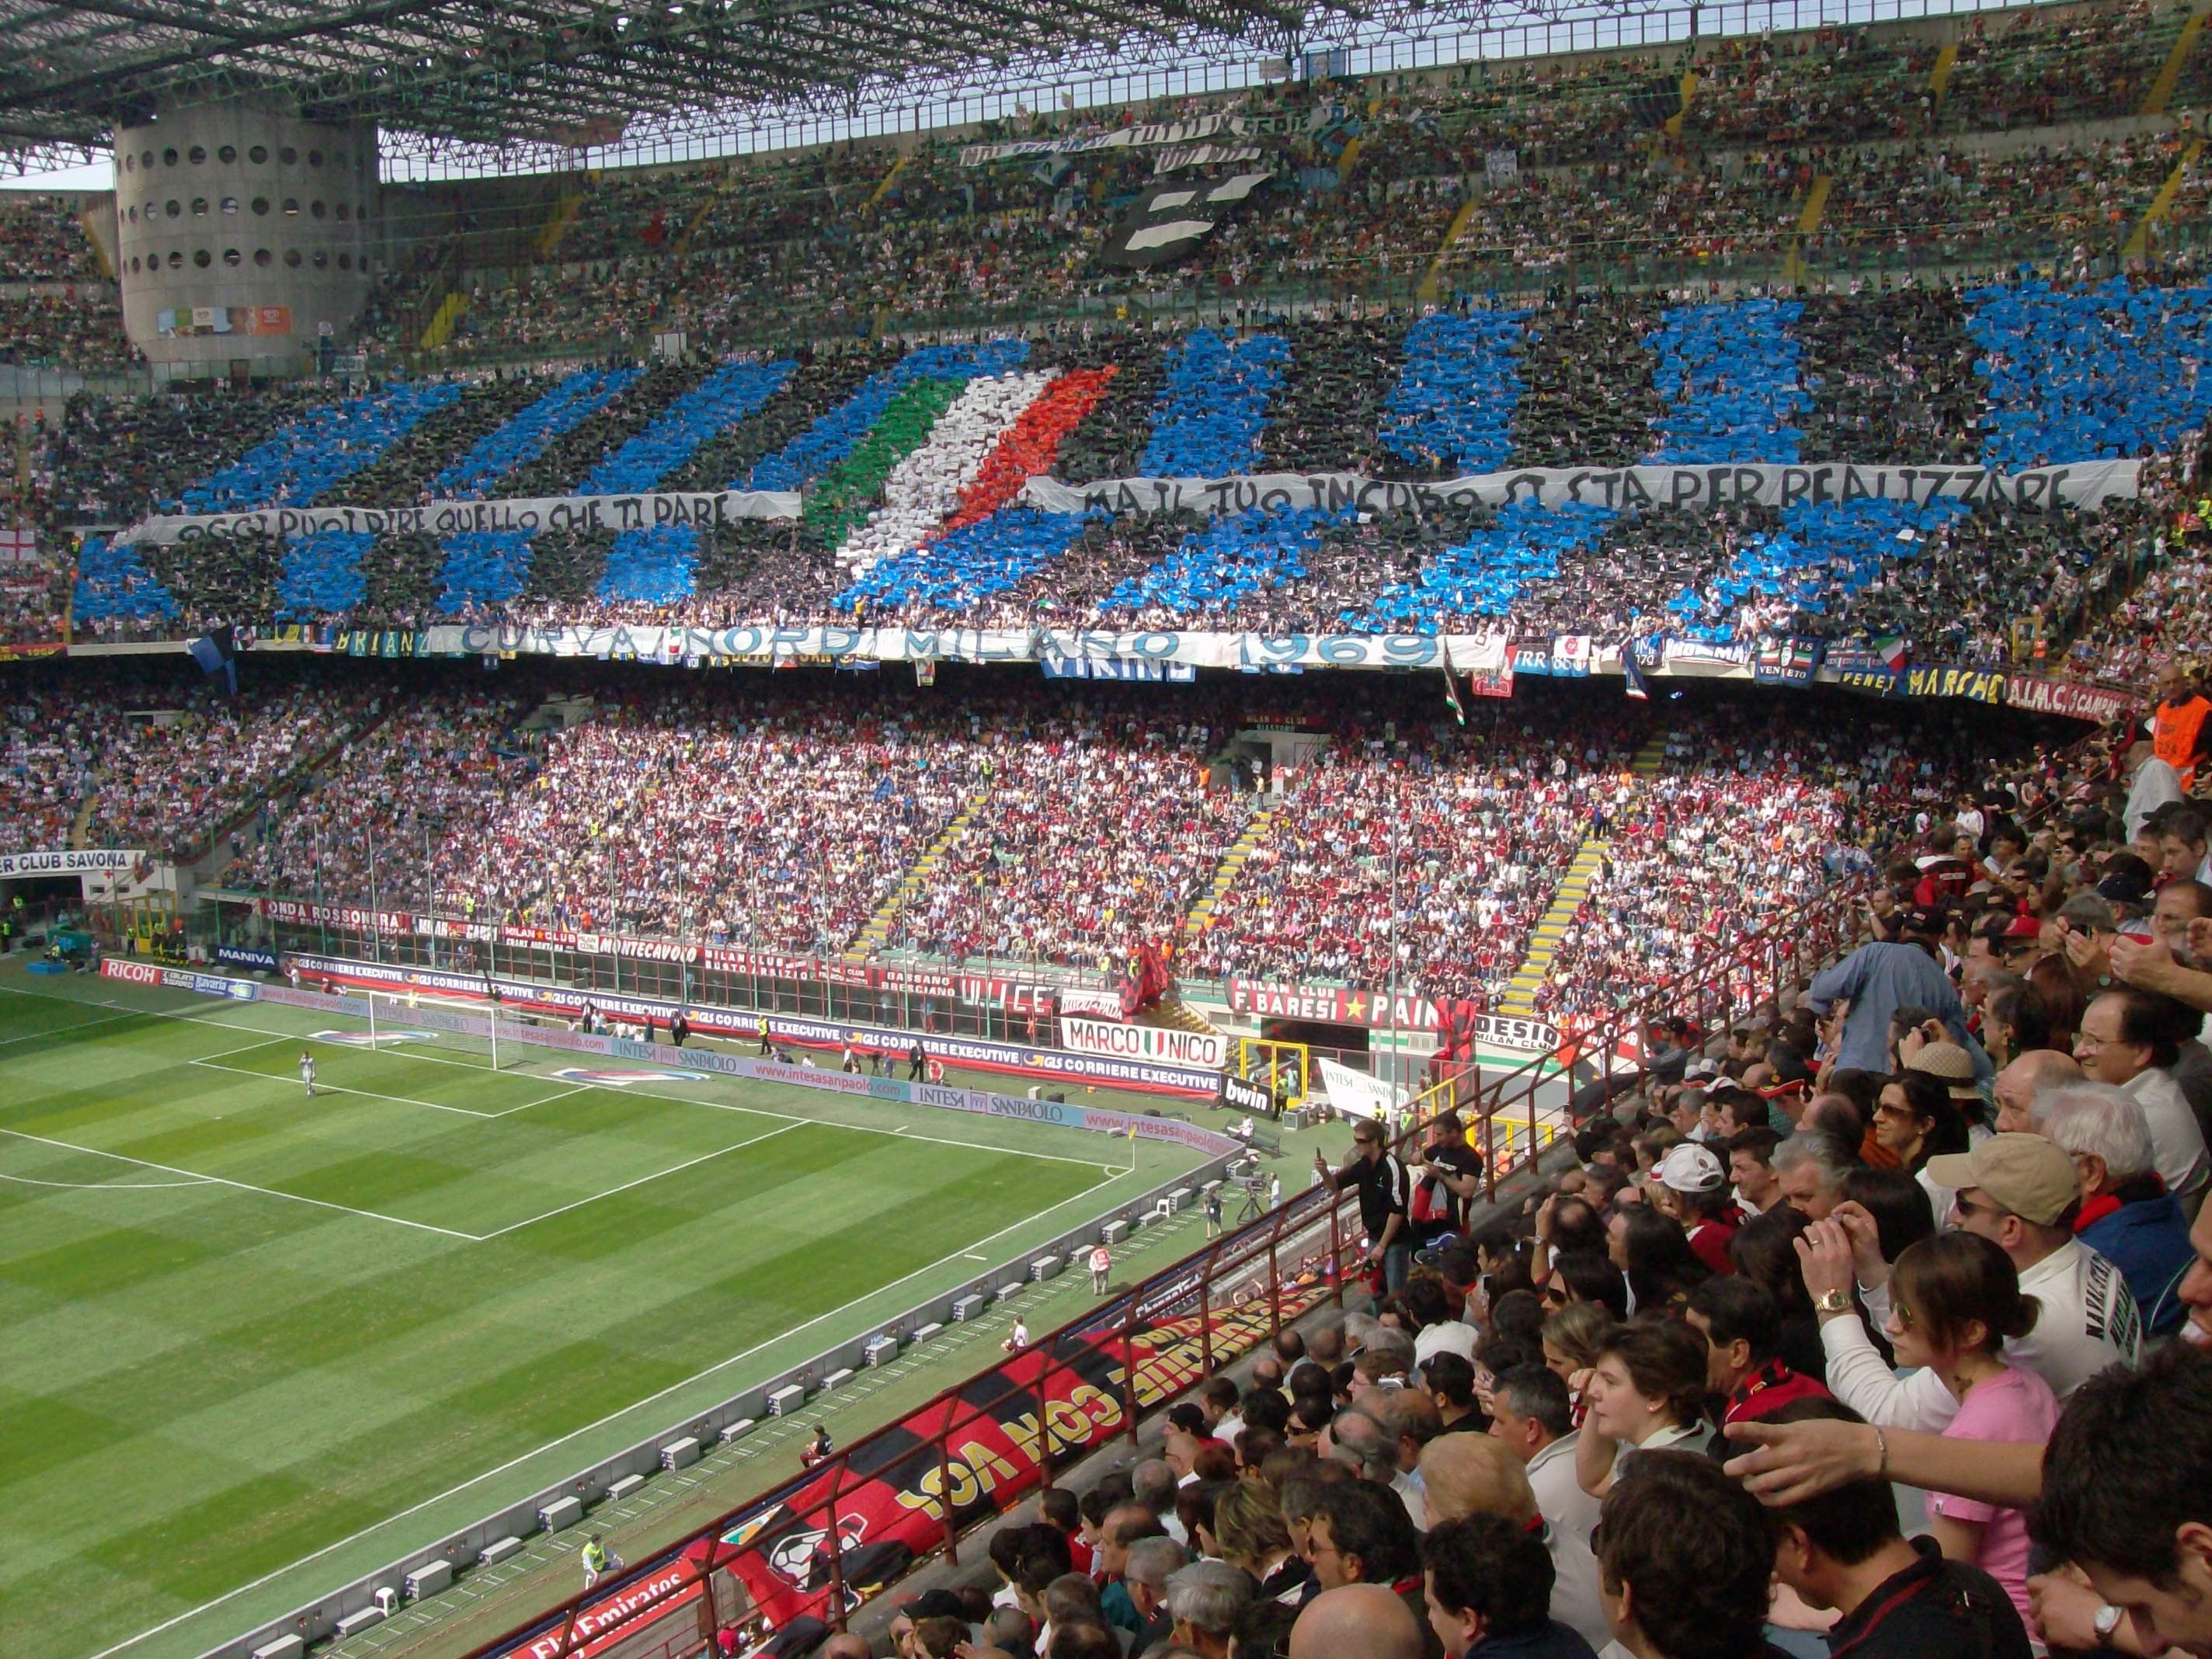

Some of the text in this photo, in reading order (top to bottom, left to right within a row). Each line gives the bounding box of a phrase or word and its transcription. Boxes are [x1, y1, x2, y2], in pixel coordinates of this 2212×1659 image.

[1084, 481, 1142, 513] MA
[1205, 479, 1292, 513] TUO
[1308, 476, 1484, 513] INCUBO
[1499, 473, 1546, 510] SI
[1567, 470, 1653, 509] STA
[1670, 467, 1765, 510] PER
[1781, 465, 2071, 511] REALIZZARE
[279, 509, 355, 537] PUOI
[365, 509, 426, 536] DIRE
[436, 503, 539, 532] QUELLO
[549, 499, 604, 530] CHE
[614, 497, 642, 527] TI
[654, 492, 730, 528] DARE
[463, 624, 639, 655] CURVA
[685, 625, 860, 657] NORD
[1230, 633, 1439, 666] 1969
[19, 855, 61, 870] CLUB
[67, 853, 127, 868] SAVONA
[268, 901, 307, 917] ONDA
[312, 906, 399, 928] ROSSONERA
[505, 927, 535, 939] MILAN
[218, 948, 275, 966] MANIVA
[311, 960, 355, 976] CORRIERE
[356, 965, 403, 982] EXECUTIVE
[705, 949, 746, 964] MILAN
[750, 954, 784, 967] CLUB
[705, 960, 746, 974] BUSTO
[752, 966, 809, 980] ARSIZIO
[106, 961, 155, 983] RICOH
[433, 976, 482, 992] CORRIERE
[886, 971, 950, 986] BASSANO
[552, 993, 566, 1005] GLS
[881, 982, 956, 996] BRESCIANO
[1236, 979, 1336, 999] MILAN CLUB
[1255, 993, 1337, 1021] BARESI
[699, 1011, 841, 1041] GLS CORRIEE EXECUTIVE
[1474, 1032, 1515, 1046] MILAN
[1475, 1016, 1559, 1047] DESIO
[620, 1041, 736, 1072] INTESA SANPAOLO
[862, 1032, 1020, 1065] GLS CORRERE EXECUTIVE
[1069, 1020, 1216, 1065] MARCO NICO
[755, 1063, 900, 1096] www.intesasanpaolo.com
[1044, 1056, 1219, 1090] GLS CORRIERE EXECUTIVE
[919, 1088, 1063, 1122] INTESA SANPAOLO
[1226, 1077, 1268, 1111] bwin
[1001, 1385, 1123, 1457] CON
[895, 1441, 1019, 1521] VOI
[583, 1573, 689, 1644] Emirates
